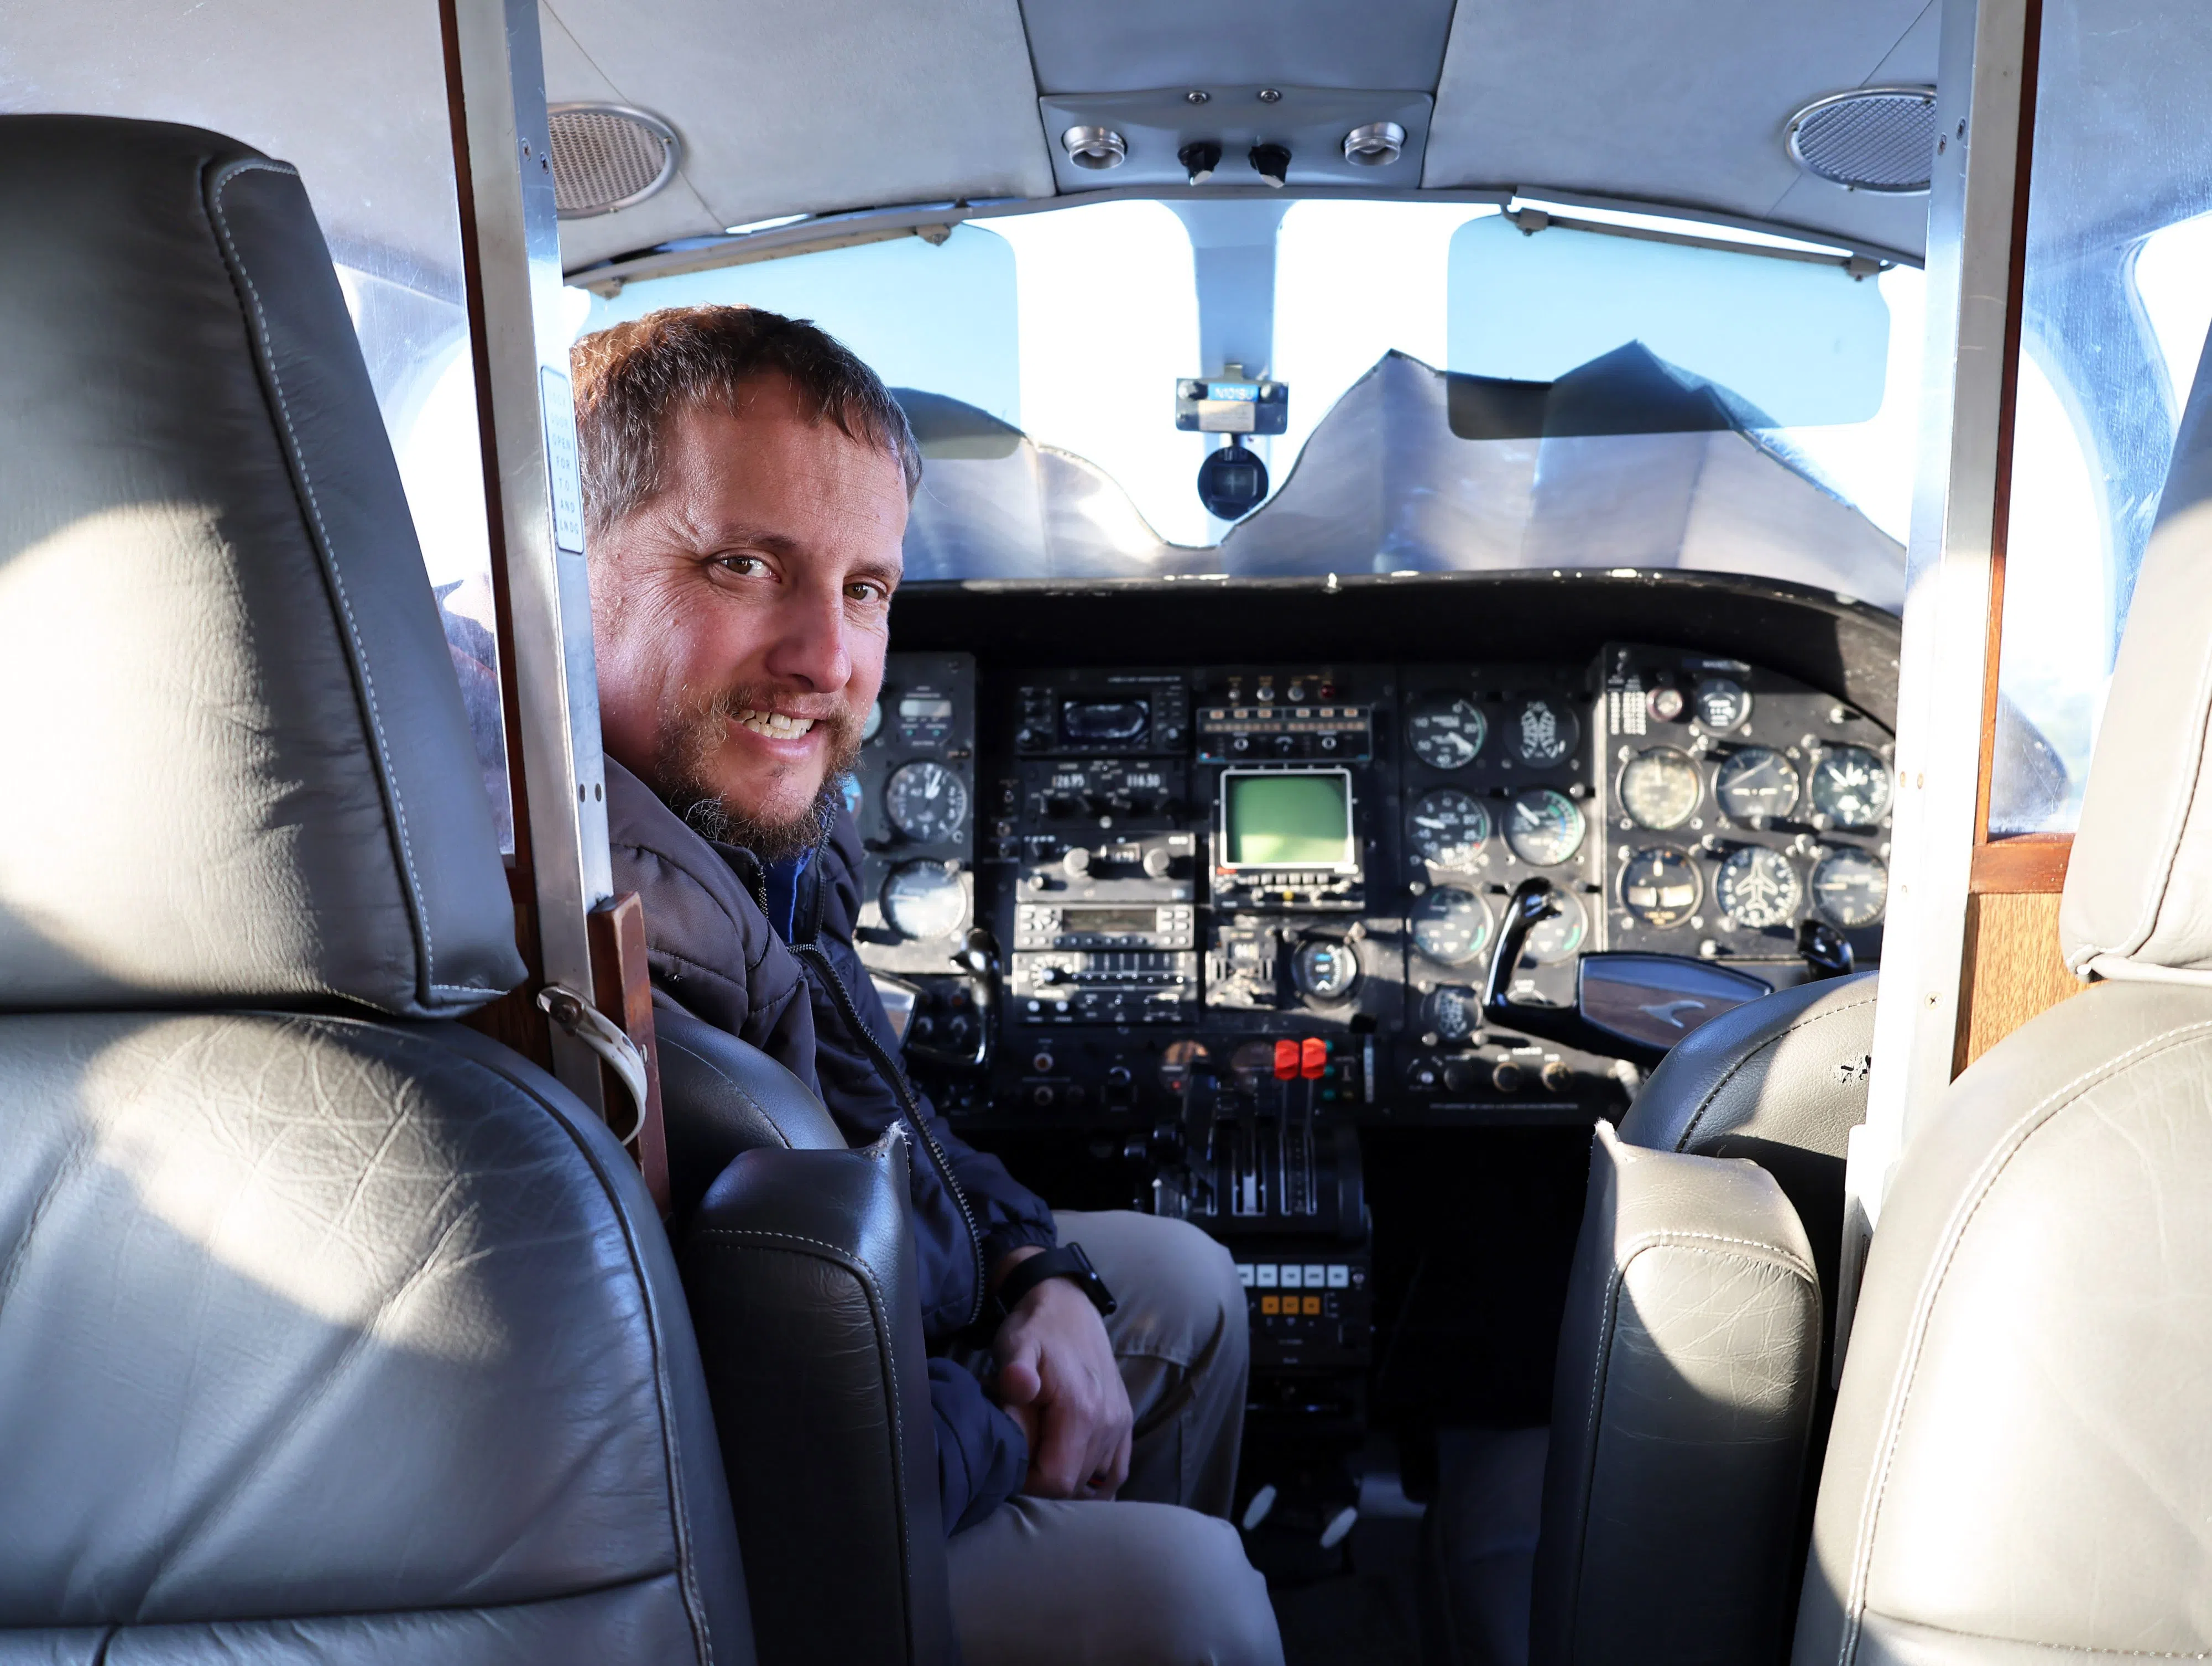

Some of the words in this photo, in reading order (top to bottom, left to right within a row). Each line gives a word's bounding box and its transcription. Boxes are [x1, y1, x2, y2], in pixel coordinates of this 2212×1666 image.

[552, 434, 571, 451] OPEN
[556, 455, 570, 470] FOR
[560, 498, 575, 514] AND
[559, 519, 578, 535] LNDG
